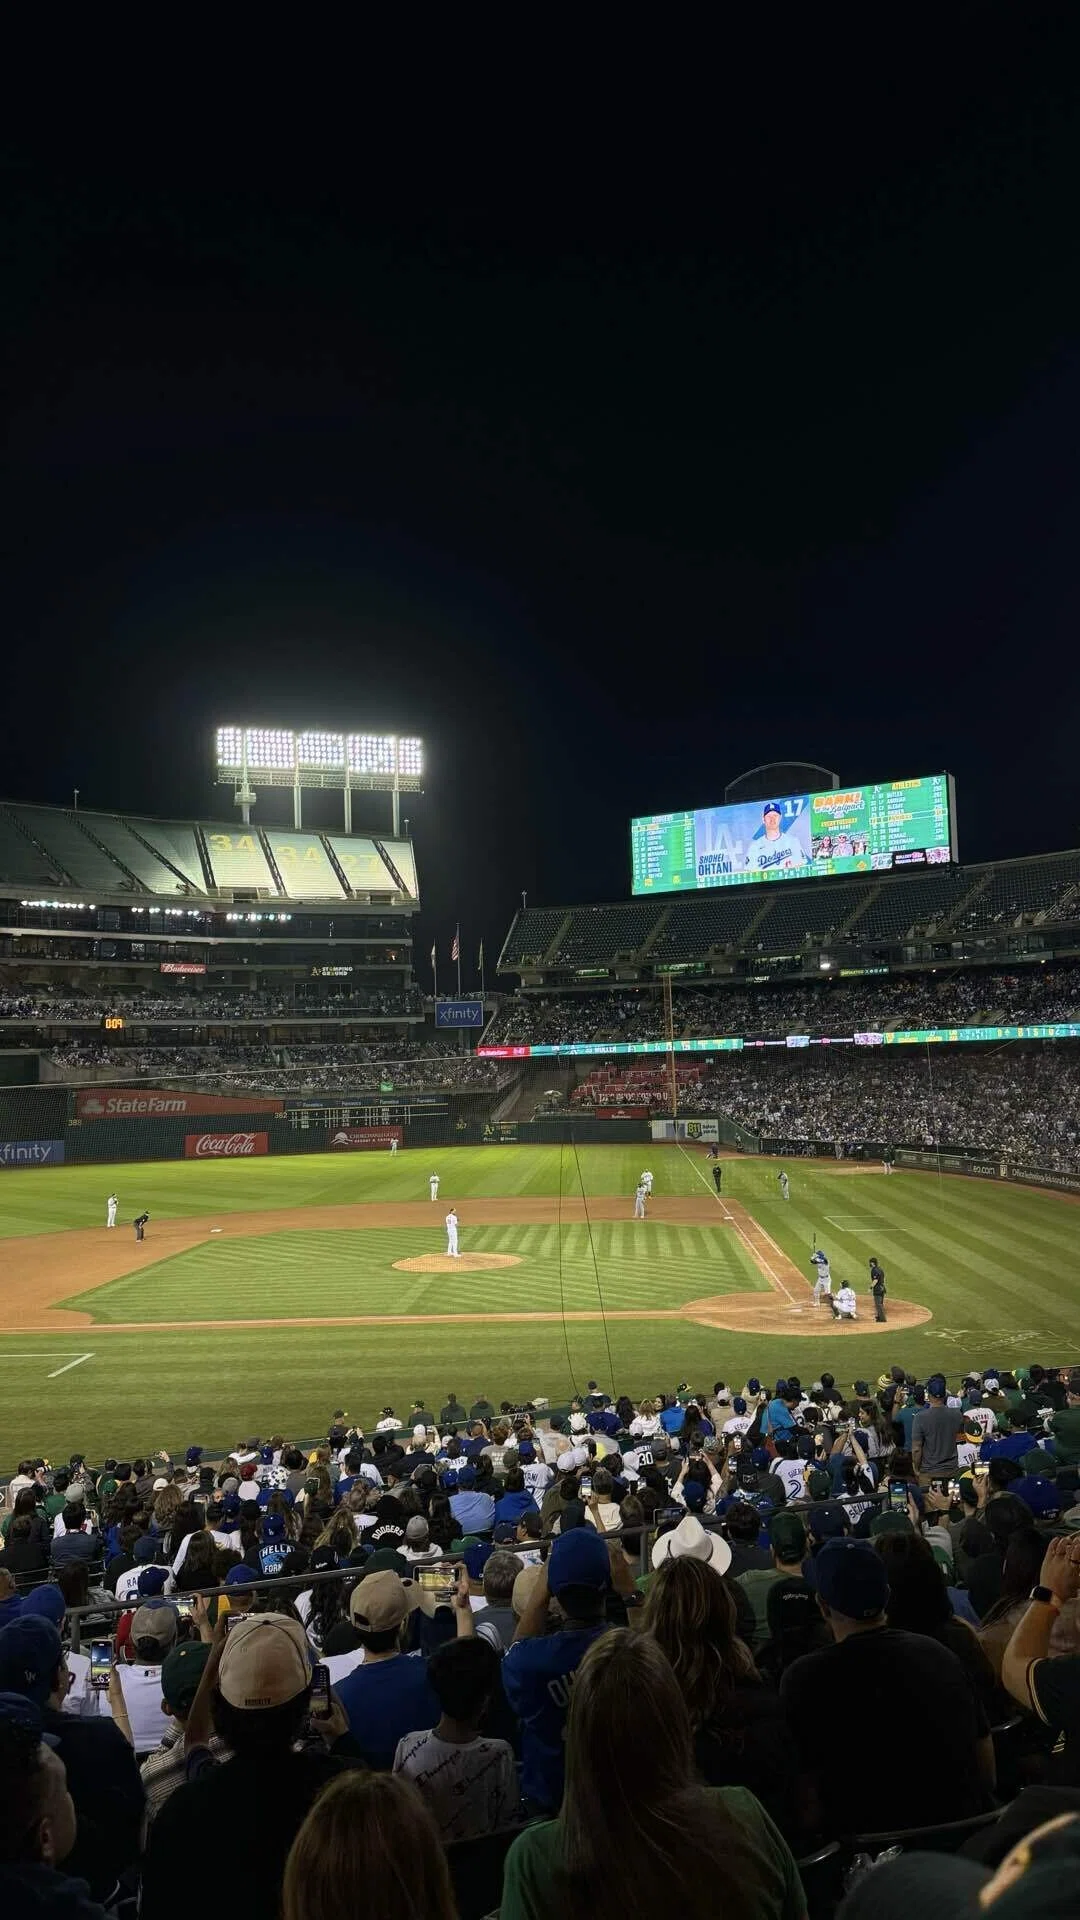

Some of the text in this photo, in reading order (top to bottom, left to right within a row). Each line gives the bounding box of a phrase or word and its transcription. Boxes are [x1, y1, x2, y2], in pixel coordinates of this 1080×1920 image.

[783, 799, 804, 817] 17
[699, 853, 725, 864] SHOHEI
[758, 848, 793, 868] Dodgers
[698, 861, 733, 876] OHTANI
[162, 963, 206, 974] Budweiser
[439, 1007, 479, 1022] xfinity
[105, 1018, 123, 1029] 0:09
[688, 1123, 701, 1133] 811
[639, 1451, 654, 1466] 30
[786, 1479, 802, 1500] 2
[371, 1524, 405, 1540] DODGERS
[262, 1544, 292, 1557] HELLA
[126, 1577, 138, 1588] RA
